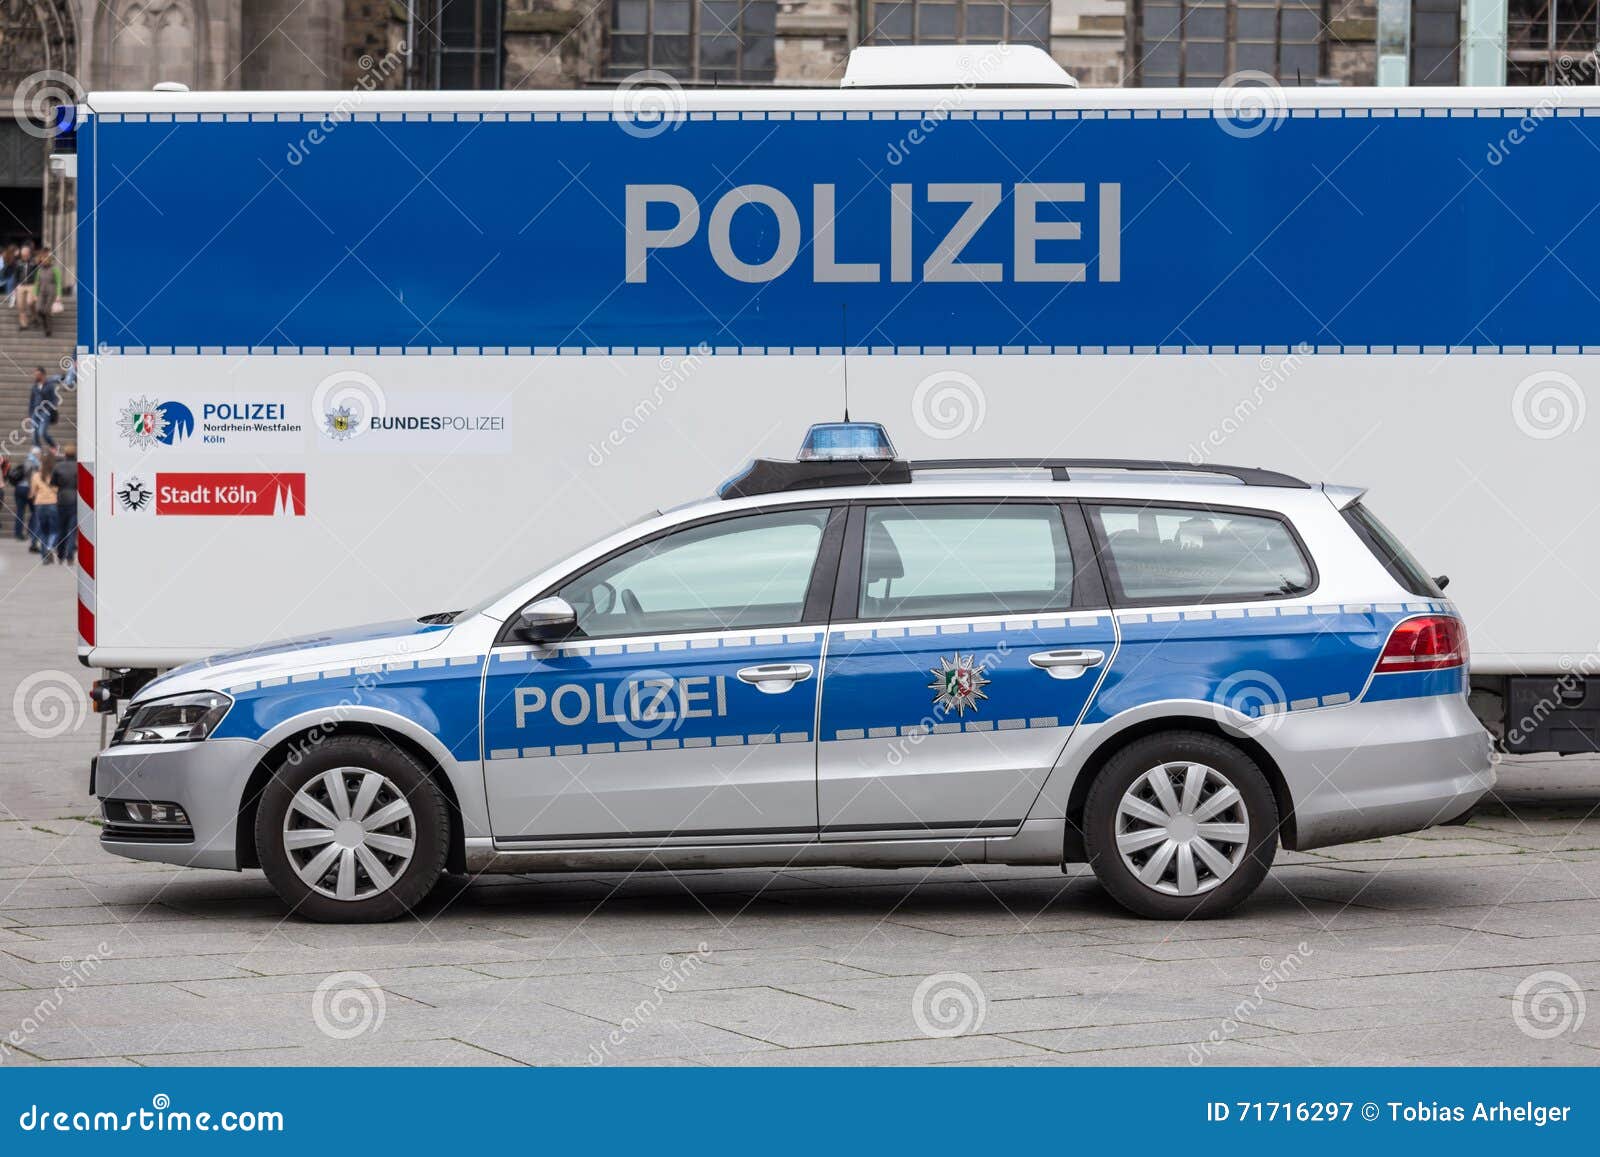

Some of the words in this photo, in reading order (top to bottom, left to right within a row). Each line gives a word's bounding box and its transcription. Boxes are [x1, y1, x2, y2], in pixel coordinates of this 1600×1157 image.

[624, 183, 1122, 284] POLIZEI
[203, 403, 286, 420] POLIZEI
[203, 423, 302, 432] Nordrhein-Westfalen
[370, 417, 504, 430] BUNDESPOLIZEI
[203, 435, 226, 443] Köln
[160, 484, 209, 504] Stadt
[215, 484, 257, 504] Köln
[514, 675, 728, 729] POLIZEI
